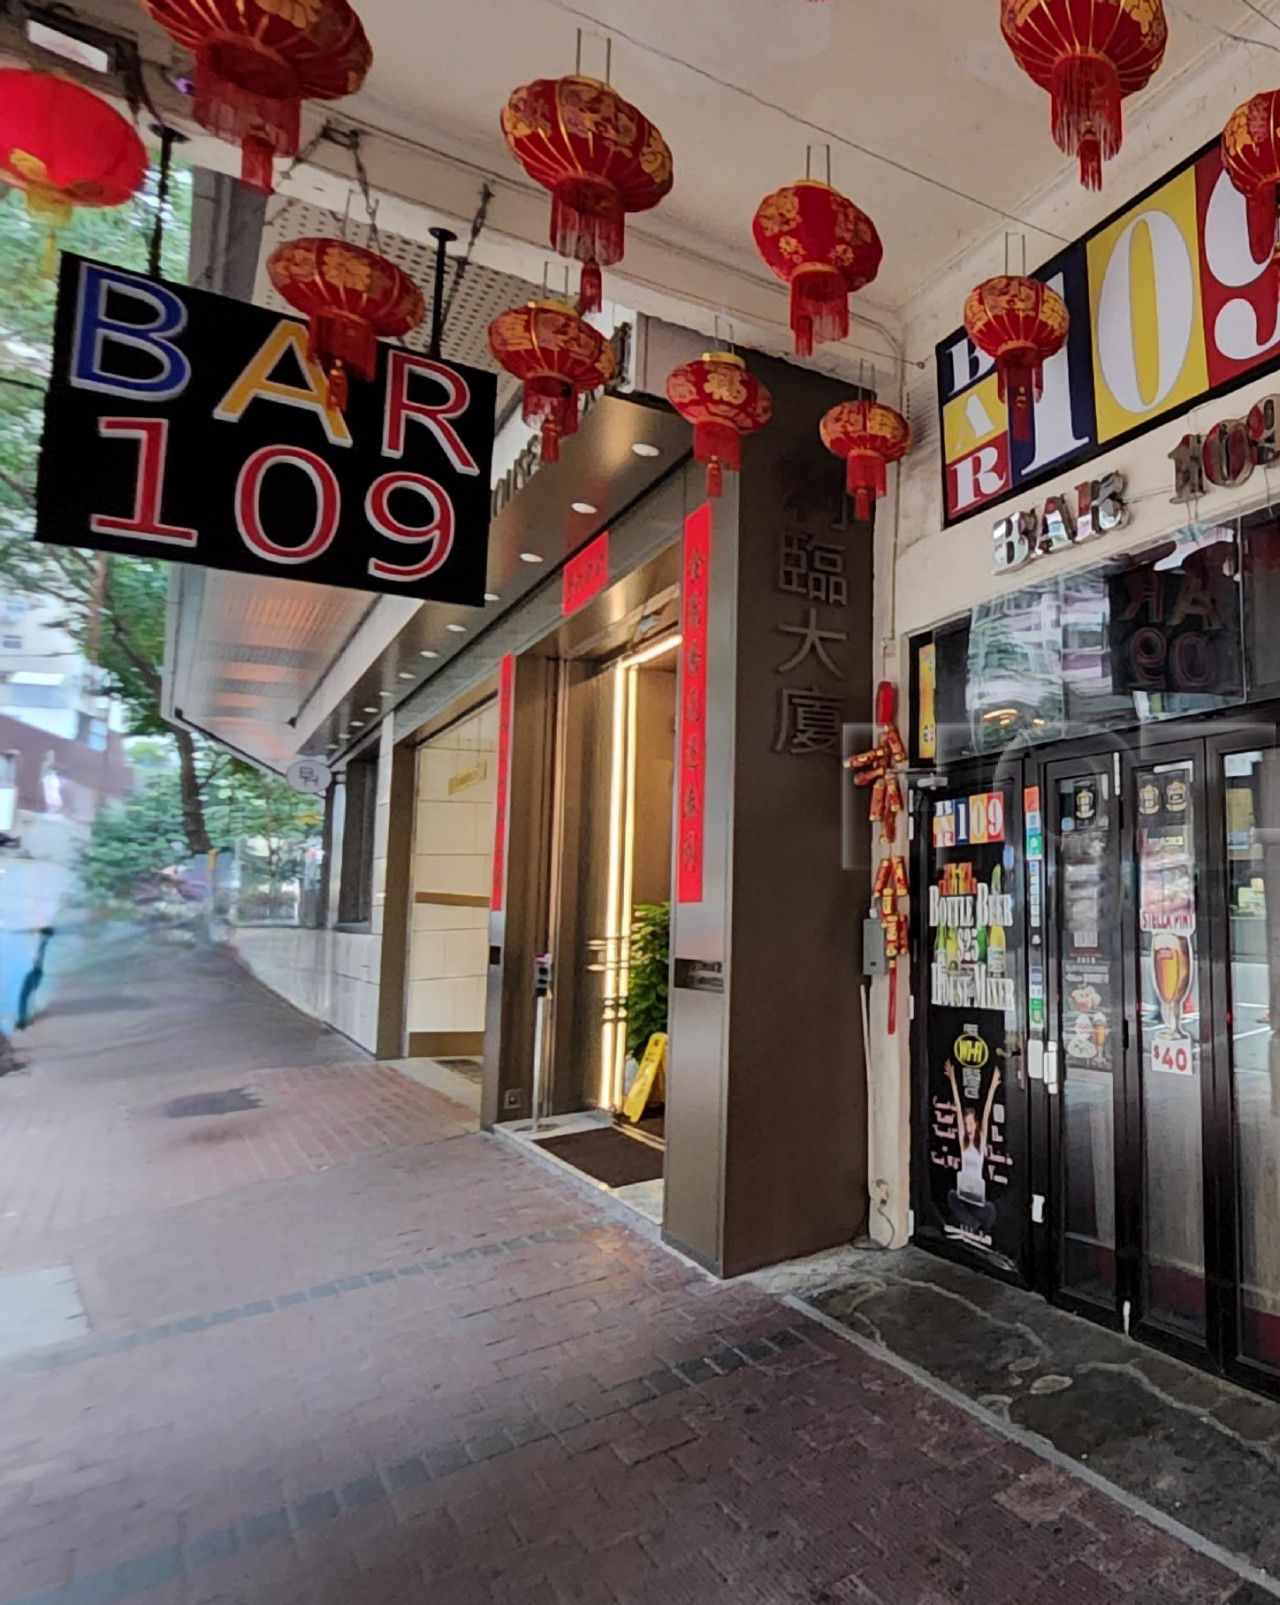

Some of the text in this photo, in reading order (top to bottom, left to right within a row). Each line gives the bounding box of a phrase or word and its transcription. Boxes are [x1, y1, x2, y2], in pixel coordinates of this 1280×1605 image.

[70, 261, 480, 476] BAR
[90, 417, 456, 582] 109
[992, 470, 1131, 576] BAR
[774, 495, 849, 754] 臨大廈
[957, 798, 1004, 840] 109
[1153, 1044, 1188, 1072] $40
